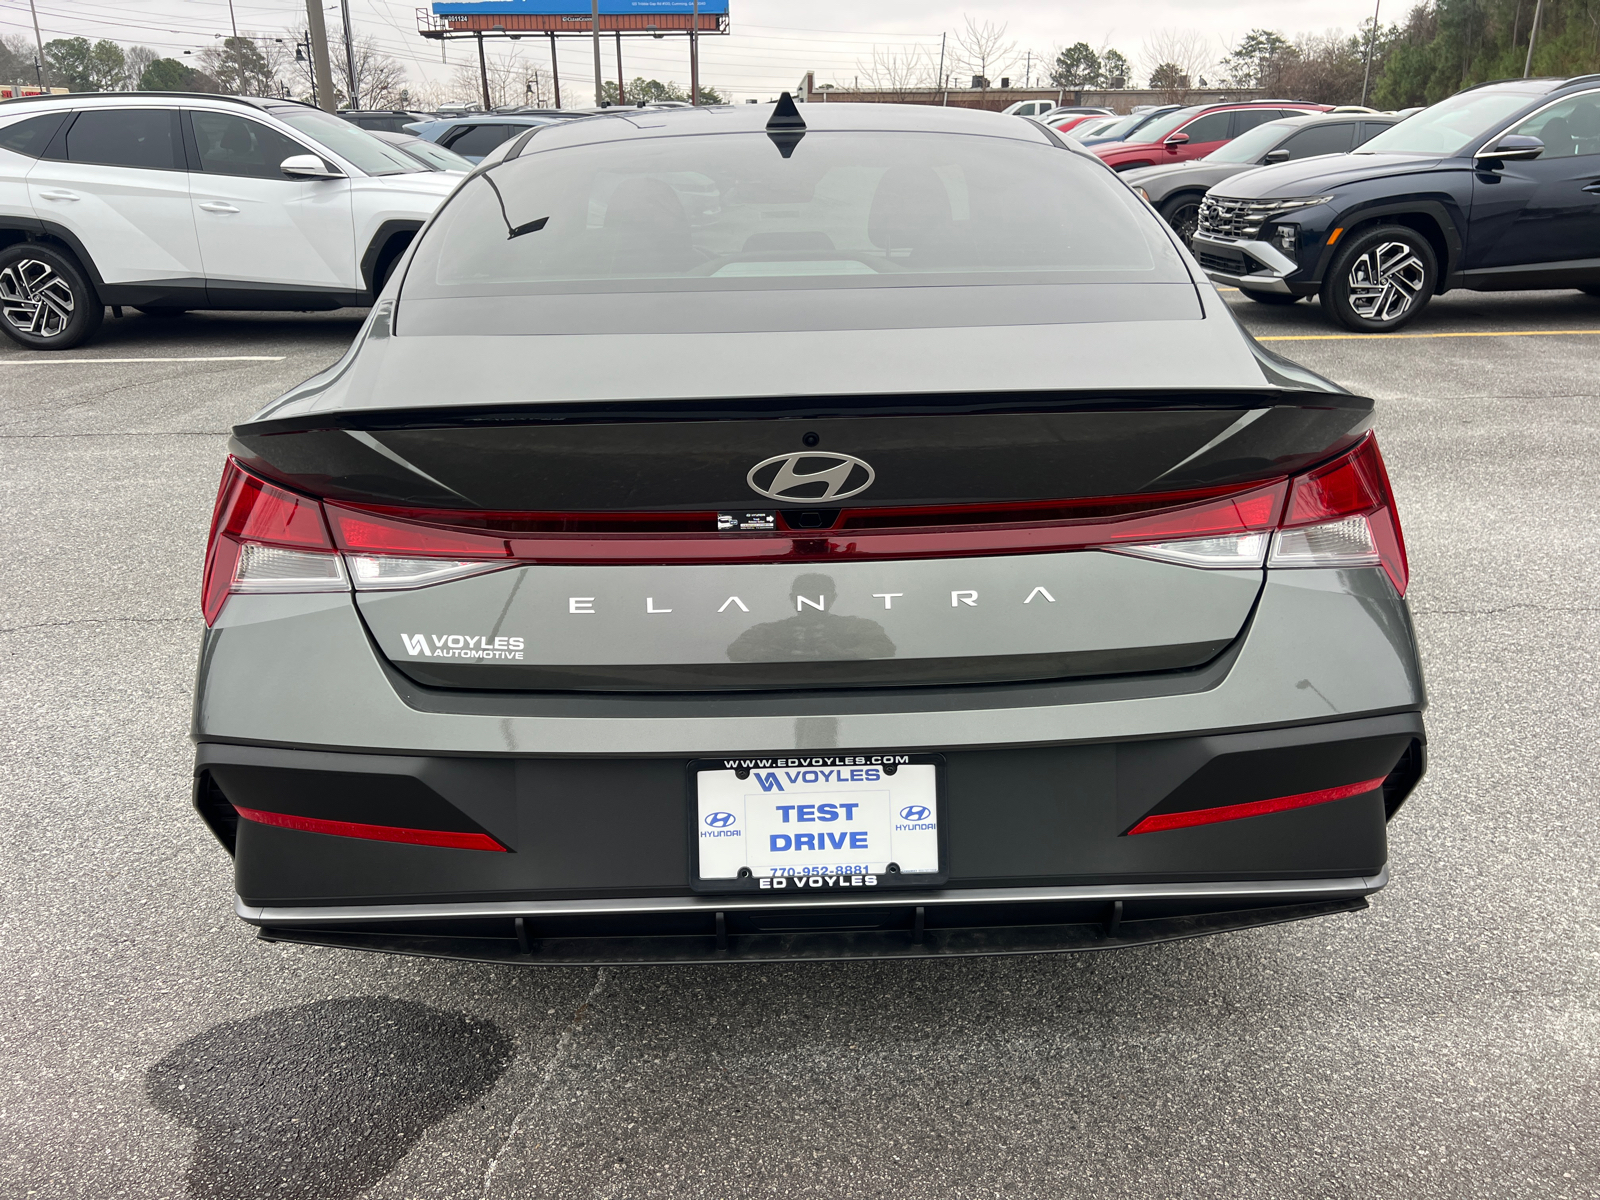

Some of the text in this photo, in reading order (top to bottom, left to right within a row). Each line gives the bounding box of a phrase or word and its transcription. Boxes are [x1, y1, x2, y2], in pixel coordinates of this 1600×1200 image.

[568, 586, 1056, 614] ELANTRA
[432, 634, 524, 650] VOYLES
[433, 649, 524, 660] AUTOMOTIVE
[724, 756, 909, 768] WWW.EDVOYLES.COM
[785, 768, 880, 784] VOYLES
[775, 803, 859, 823] TEST
[700, 830, 741, 838] HYUNDAI
[895, 823, 937, 831] HYUNDAI
[769, 831, 869, 852] DRIVE
[770, 865, 870, 876] 770-952-8881
[759, 875, 878, 889] ED VOYLES
